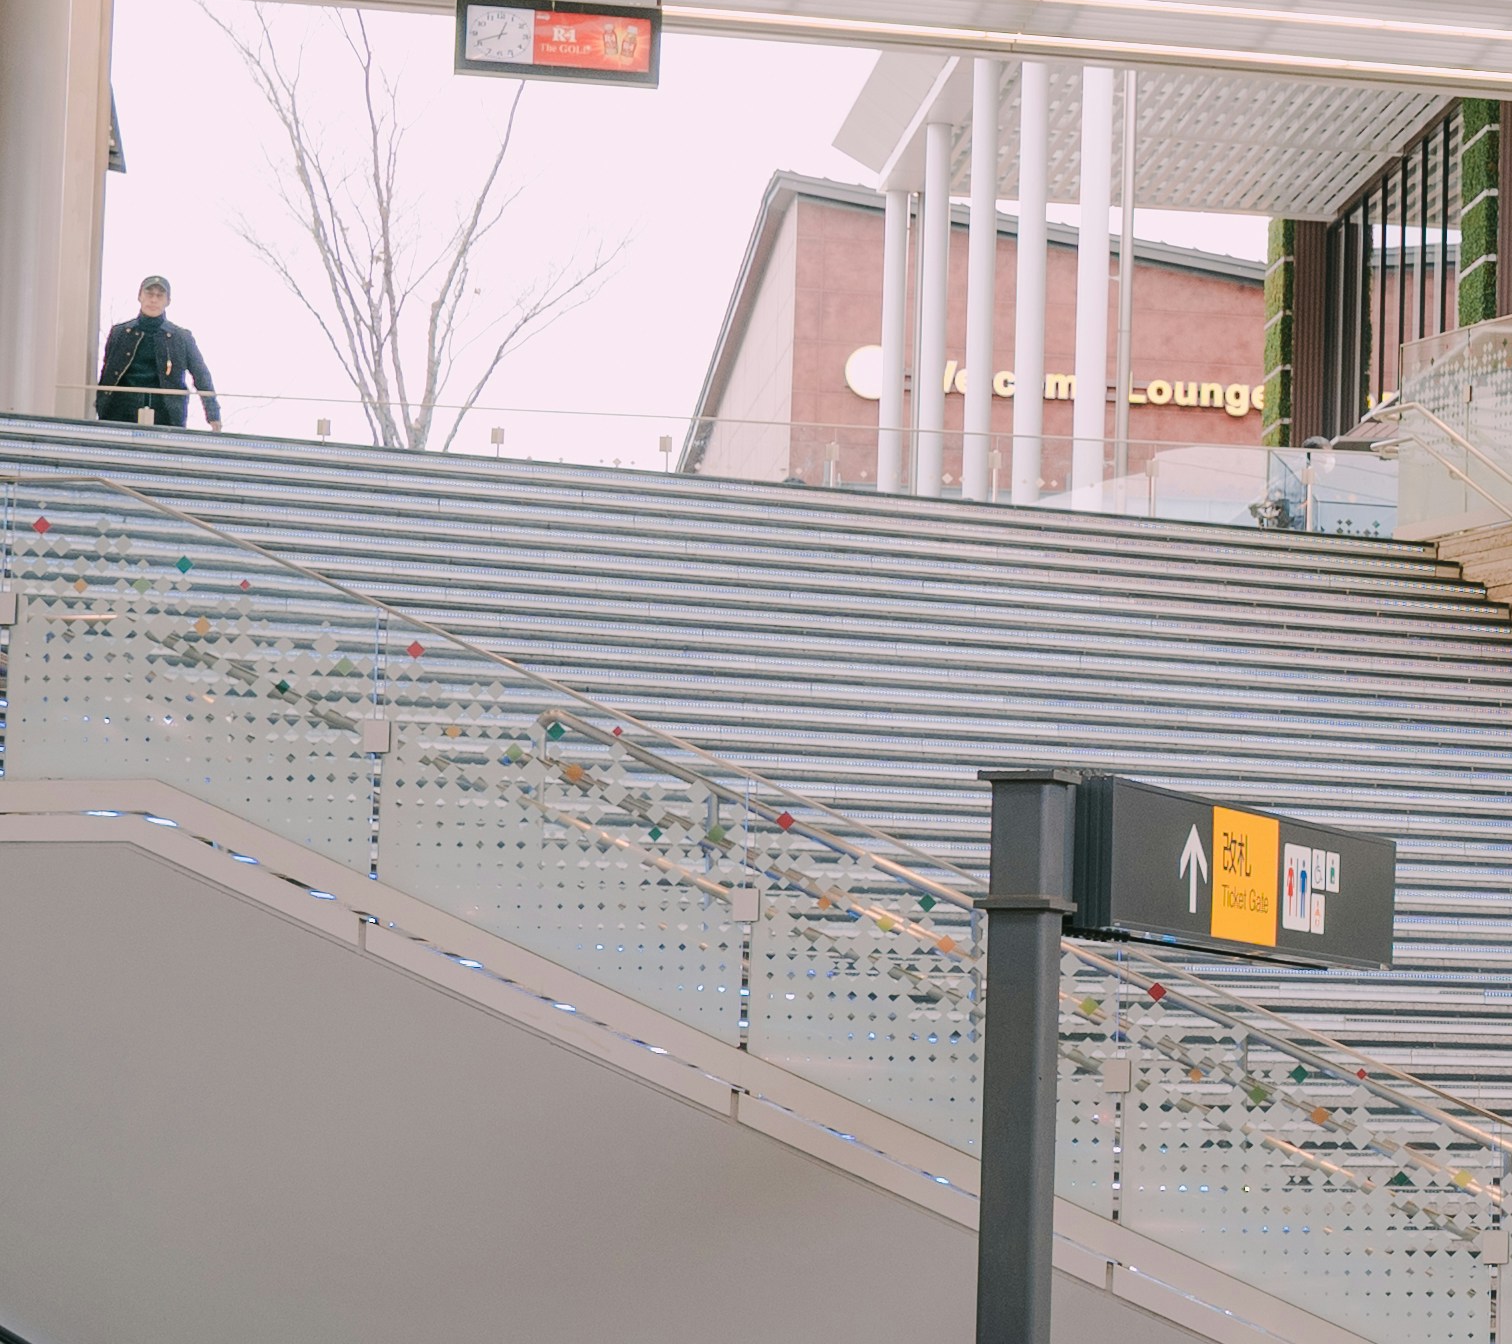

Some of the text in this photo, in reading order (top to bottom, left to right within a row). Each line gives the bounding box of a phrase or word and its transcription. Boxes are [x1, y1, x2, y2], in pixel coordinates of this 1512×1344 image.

[1223, 832, 1252, 877] 改札
[1222, 884, 1269, 914] Ticket Gate
